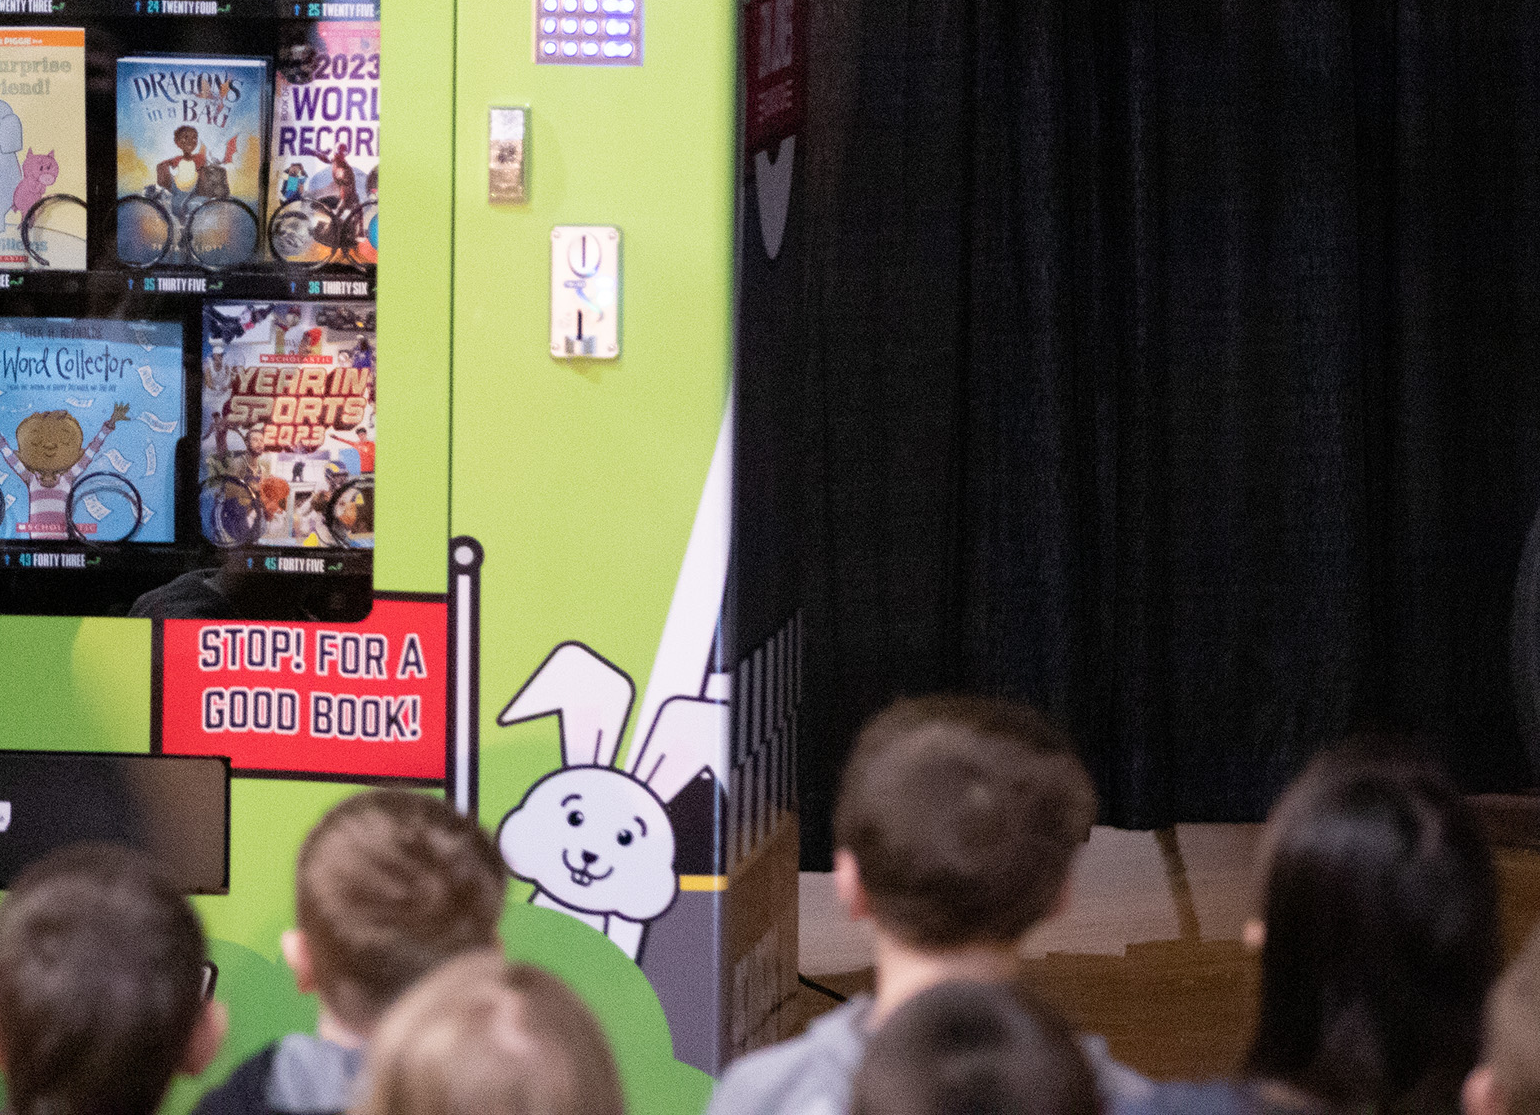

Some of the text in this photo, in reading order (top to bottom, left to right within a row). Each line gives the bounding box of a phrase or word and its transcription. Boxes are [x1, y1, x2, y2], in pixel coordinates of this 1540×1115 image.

[147, 0, 217, 15] 24 TWENTY FOUR
[308, 2, 375, 17] 25 TWENTY FIVE
[315, 53, 380, 80] 2023
[133, 70, 244, 103] DRAGONS
[146, 99, 231, 128] in a BAG
[279, 126, 380, 156] RECOR
[157, 278, 188, 291] THIRTY
[188, 278, 207, 292] FIVE
[308, 281, 368, 295] 36 THIRTY SIX
[4, 346, 52, 383] Word
[56, 344, 134, 382] Collector
[233, 367, 369, 395] YEAR IN
[227, 396, 367, 424] SPORTS
[264, 424, 326, 447] 2023
[19, 554, 86, 568] 43 FORTY THREE
[264, 557, 325, 572] 45 FORTY FIVE
[200, 627, 426, 678] STOP! FOR A
[203, 689, 422, 741] GOOD BOOK!
